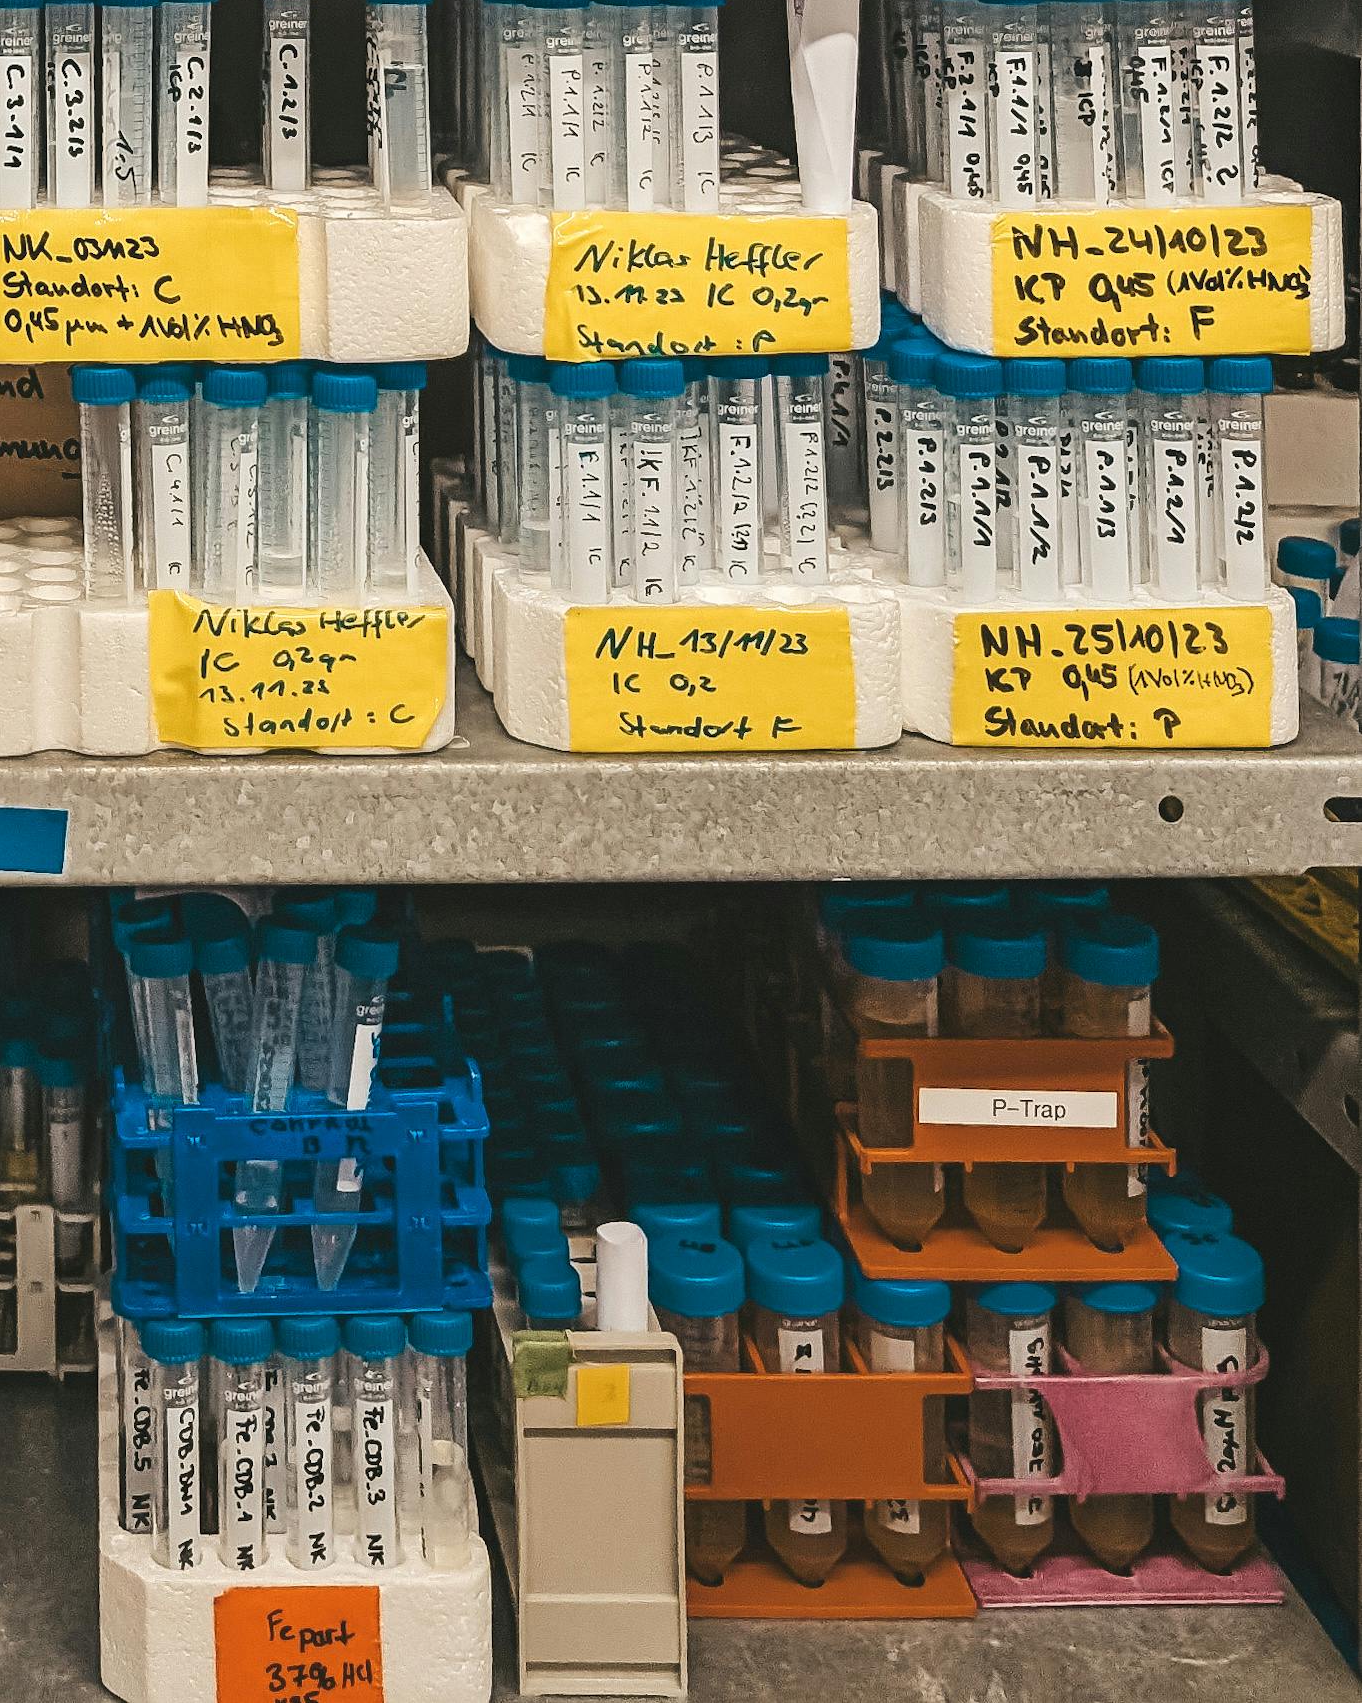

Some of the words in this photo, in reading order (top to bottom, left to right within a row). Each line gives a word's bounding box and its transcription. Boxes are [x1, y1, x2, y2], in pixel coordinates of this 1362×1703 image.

[573, 239, 692, 273] Niklas
[704, 236, 824, 278] Heffler
[153, 275, 181, 305] C
[116, 314, 135, 331] +
[1189, 304, 1215, 340] F
[717, 402, 759, 417] greiner
[1080, 418, 1125, 433] greiner
[1150, 418, 1195, 433] greiner
[1217, 417, 1262, 432] greiner
[192, 607, 307, 639] Niklas
[319, 609, 426, 639] Heffler
[200, 648, 240, 679] IC
[613, 671, 642, 695] IC
[669, 673, 717, 697] 0,2
[389, 703, 416, 725] C
[1153, 707, 1182, 739] P
[771, 715, 803, 739] F
[991, 1097, 1067, 1122] P-Trap
